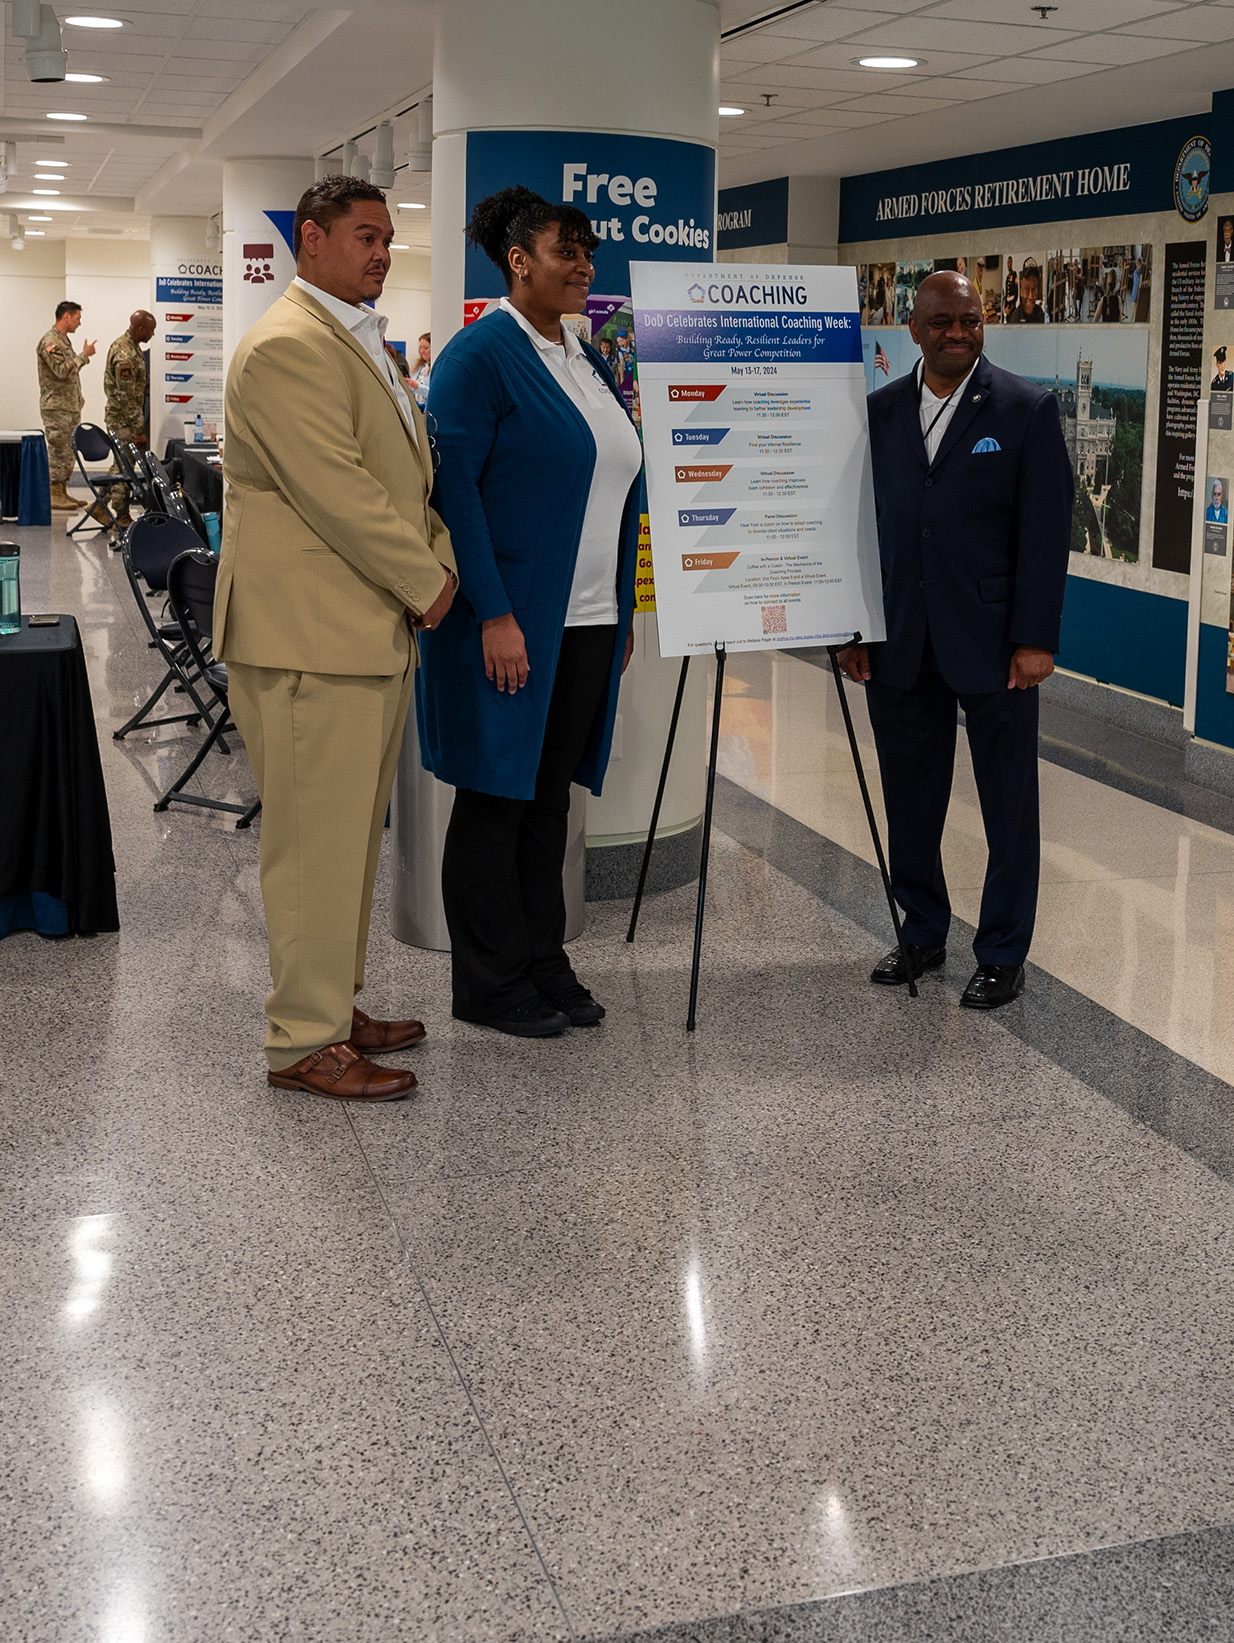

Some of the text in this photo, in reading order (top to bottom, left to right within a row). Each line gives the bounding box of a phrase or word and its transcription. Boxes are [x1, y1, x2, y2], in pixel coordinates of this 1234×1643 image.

[562, 162, 658, 208] Free
[875, 162, 1132, 222] ARMED FORCES RETIREMENT HOME
[631, 215, 710, 250] Cookies
[684, 272, 744, 280] DEPARTMENT
[707, 284, 808, 305] COACHING
[644, 314, 852, 332] DoD Celebrates International Coaching Week:
[676, 333, 825, 349] Building Ready, Resilient Leaders for
[703, 348, 802, 362] Great Power Competition
[731, 366, 743, 376] May
[763, 367, 778, 375] 2024
[681, 390, 705, 399] Monday
[685, 433, 710, 442] Tuesday
[688, 470, 722, 479] Wednesday
[692, 514, 719, 523] Thursday
[694, 558, 714, 568] Friday
[636, 578, 654, 588] pex
